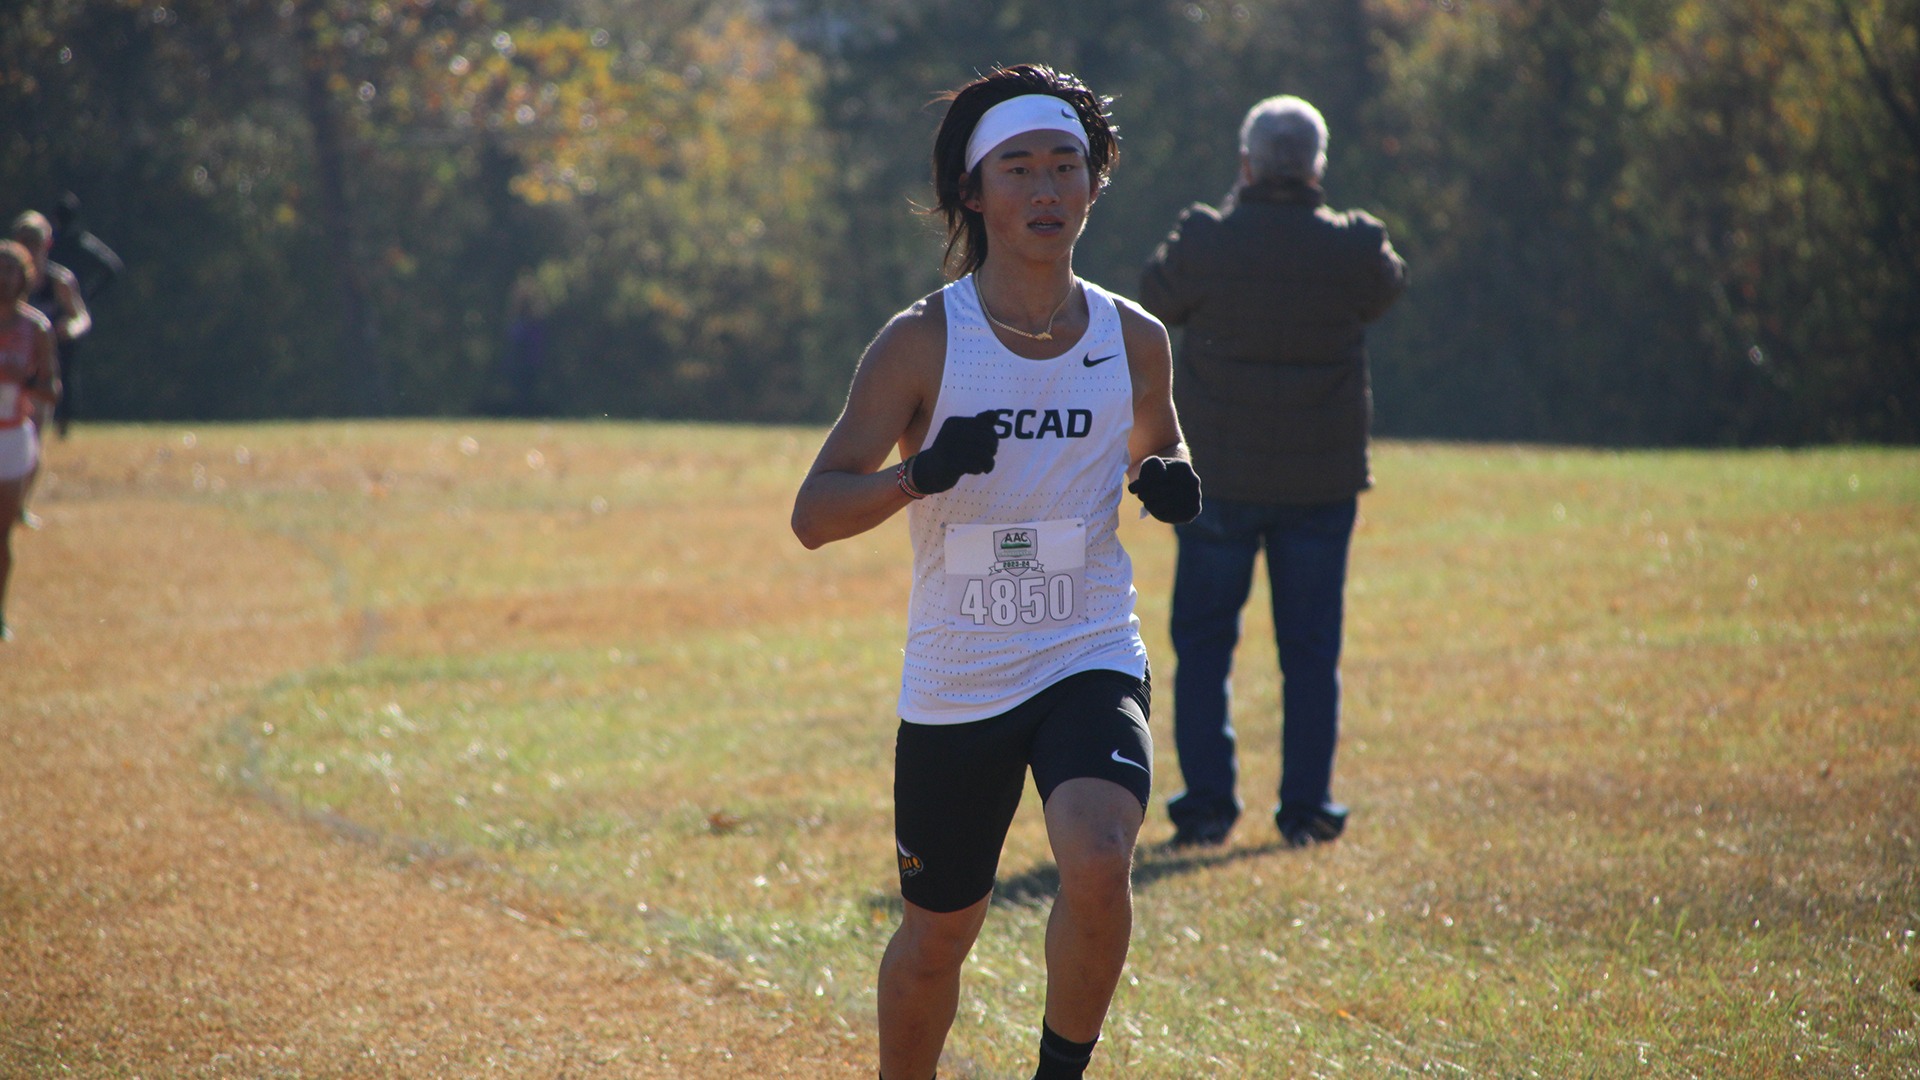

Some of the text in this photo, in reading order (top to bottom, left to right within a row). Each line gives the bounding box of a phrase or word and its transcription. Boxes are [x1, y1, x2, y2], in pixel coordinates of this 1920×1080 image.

[995, 409, 1092, 439] SCAD
[1004, 532, 1028, 542] AAC
[960, 573, 1074, 626] 4850
